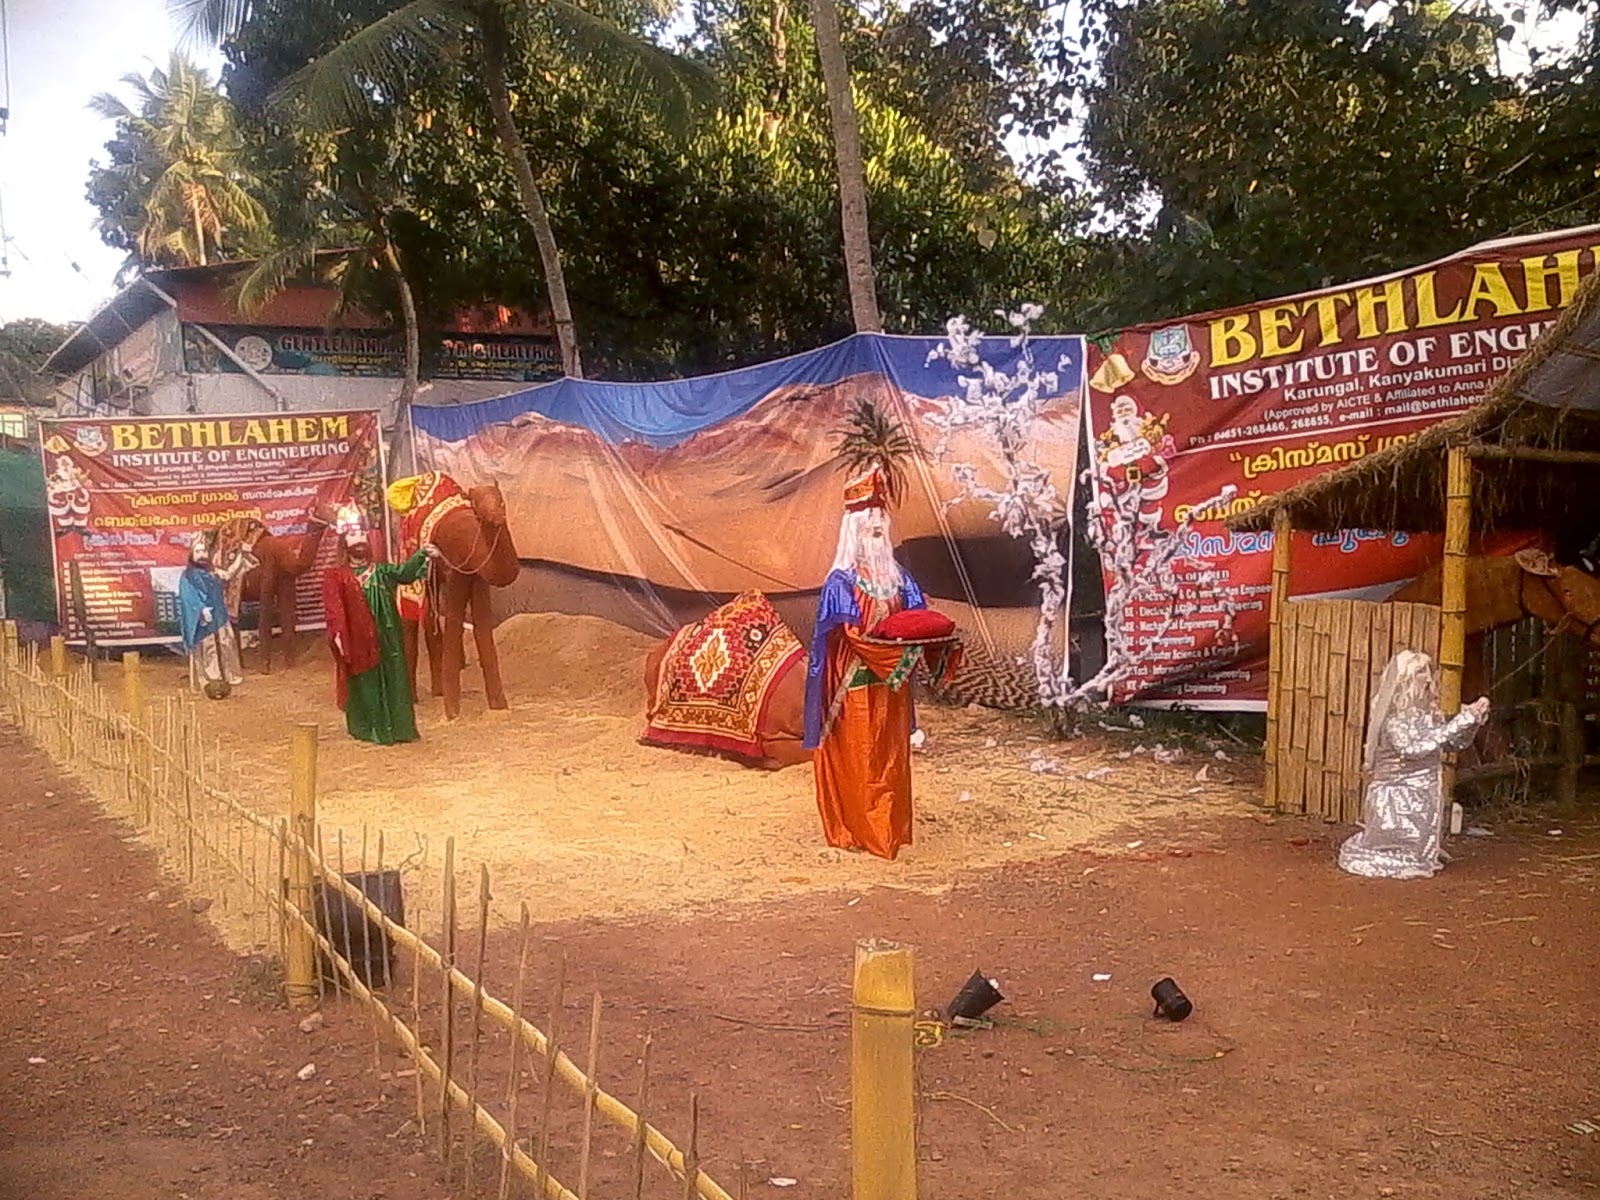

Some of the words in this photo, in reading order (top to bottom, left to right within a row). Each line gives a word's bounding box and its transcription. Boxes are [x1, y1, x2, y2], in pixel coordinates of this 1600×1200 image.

[1210, 347, 1379, 400] INSTITUTE
[1389, 336, 1438, 367] OF
[1284, 378, 1364, 402] Karungal,
[1369, 358, 1486, 388] Kanyakumari
[1264, 402, 1319, 422] (Approved
[1321, 402, 1334, 413] by
[1337, 394, 1371, 409] AICTE
[1374, 393, 1383, 403] &
[1386, 385, 1436, 401] Affiliated
[1439, 384, 1450, 394] to
[1453, 380, 1484, 393] Anna
[111, 414, 349, 451] BETHLAHEM
[112, 450, 203, 467] INSTITUTE
[207, 450, 231, 463] OF
[236, 441, 350, 461] ENGINEERING
